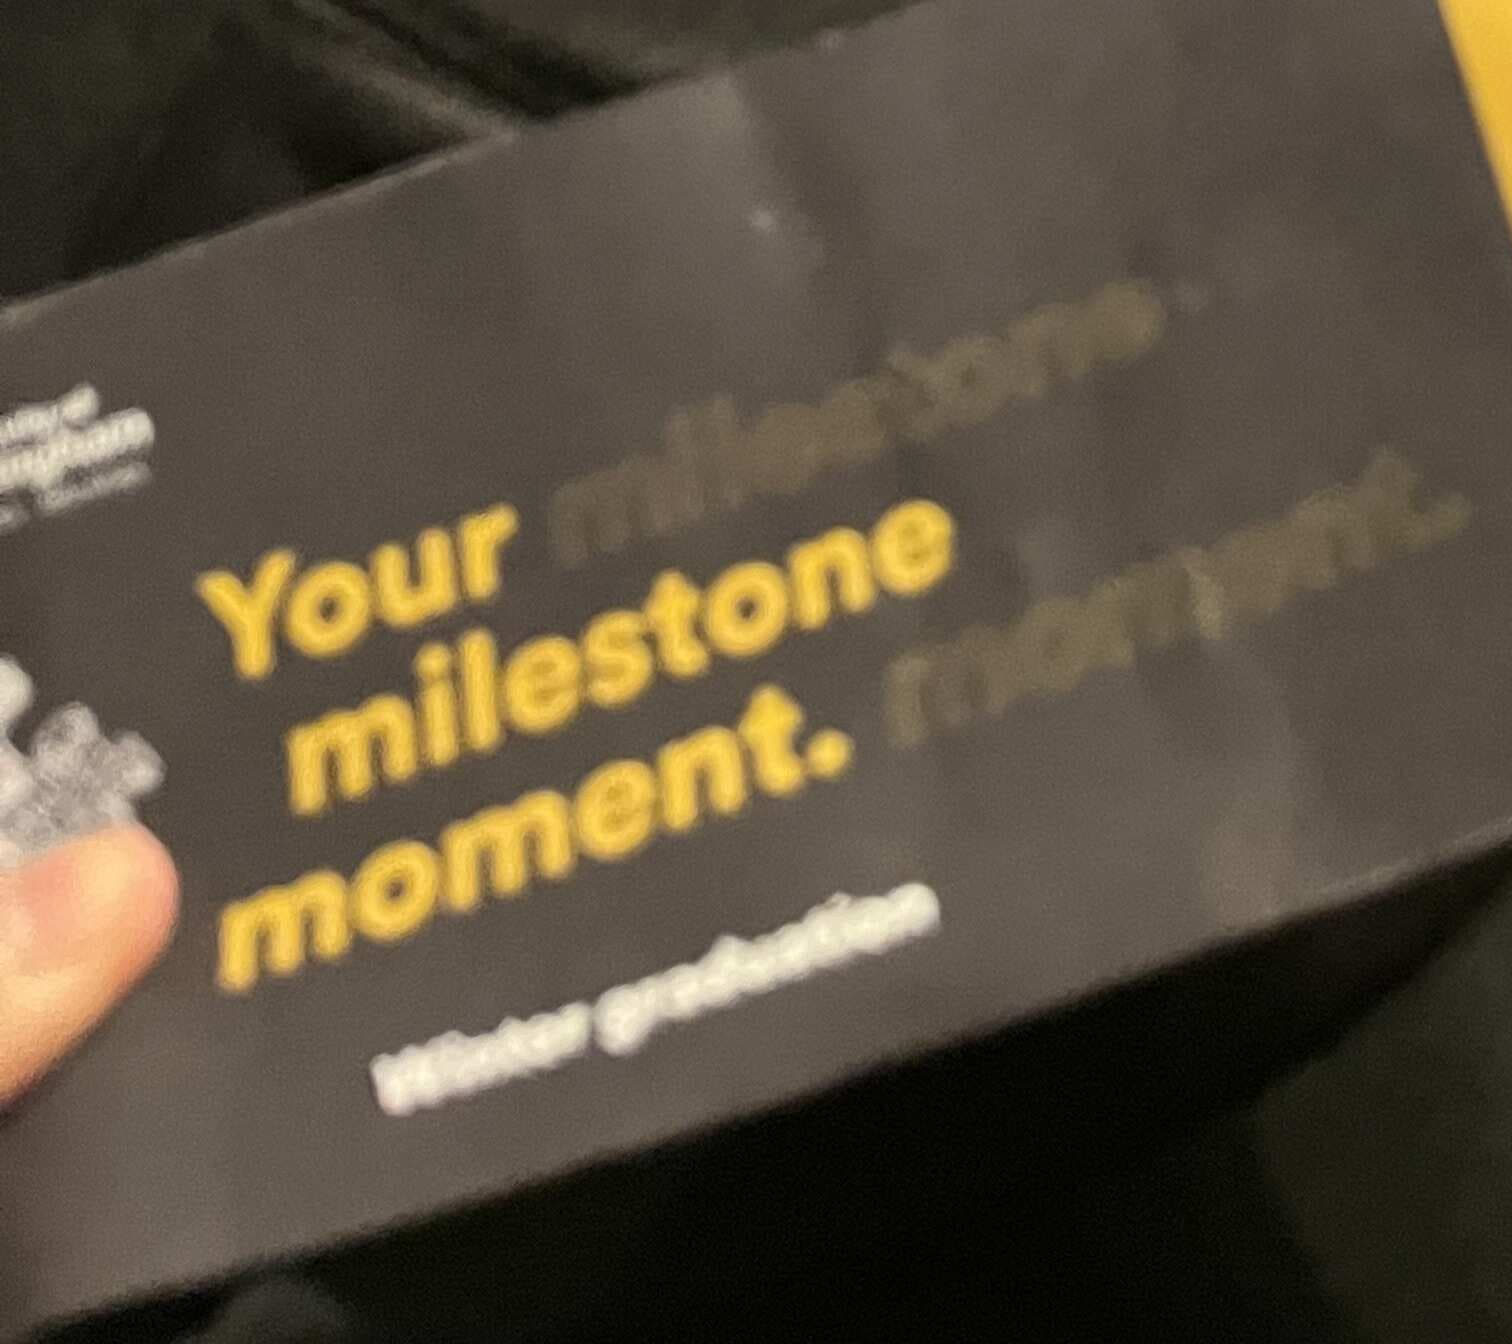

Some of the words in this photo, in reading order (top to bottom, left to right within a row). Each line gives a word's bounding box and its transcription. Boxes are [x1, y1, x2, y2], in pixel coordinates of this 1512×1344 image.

[198, 504, 518, 680] Your
[286, 499, 955, 817] milestone
[217, 685, 852, 994] moment.
